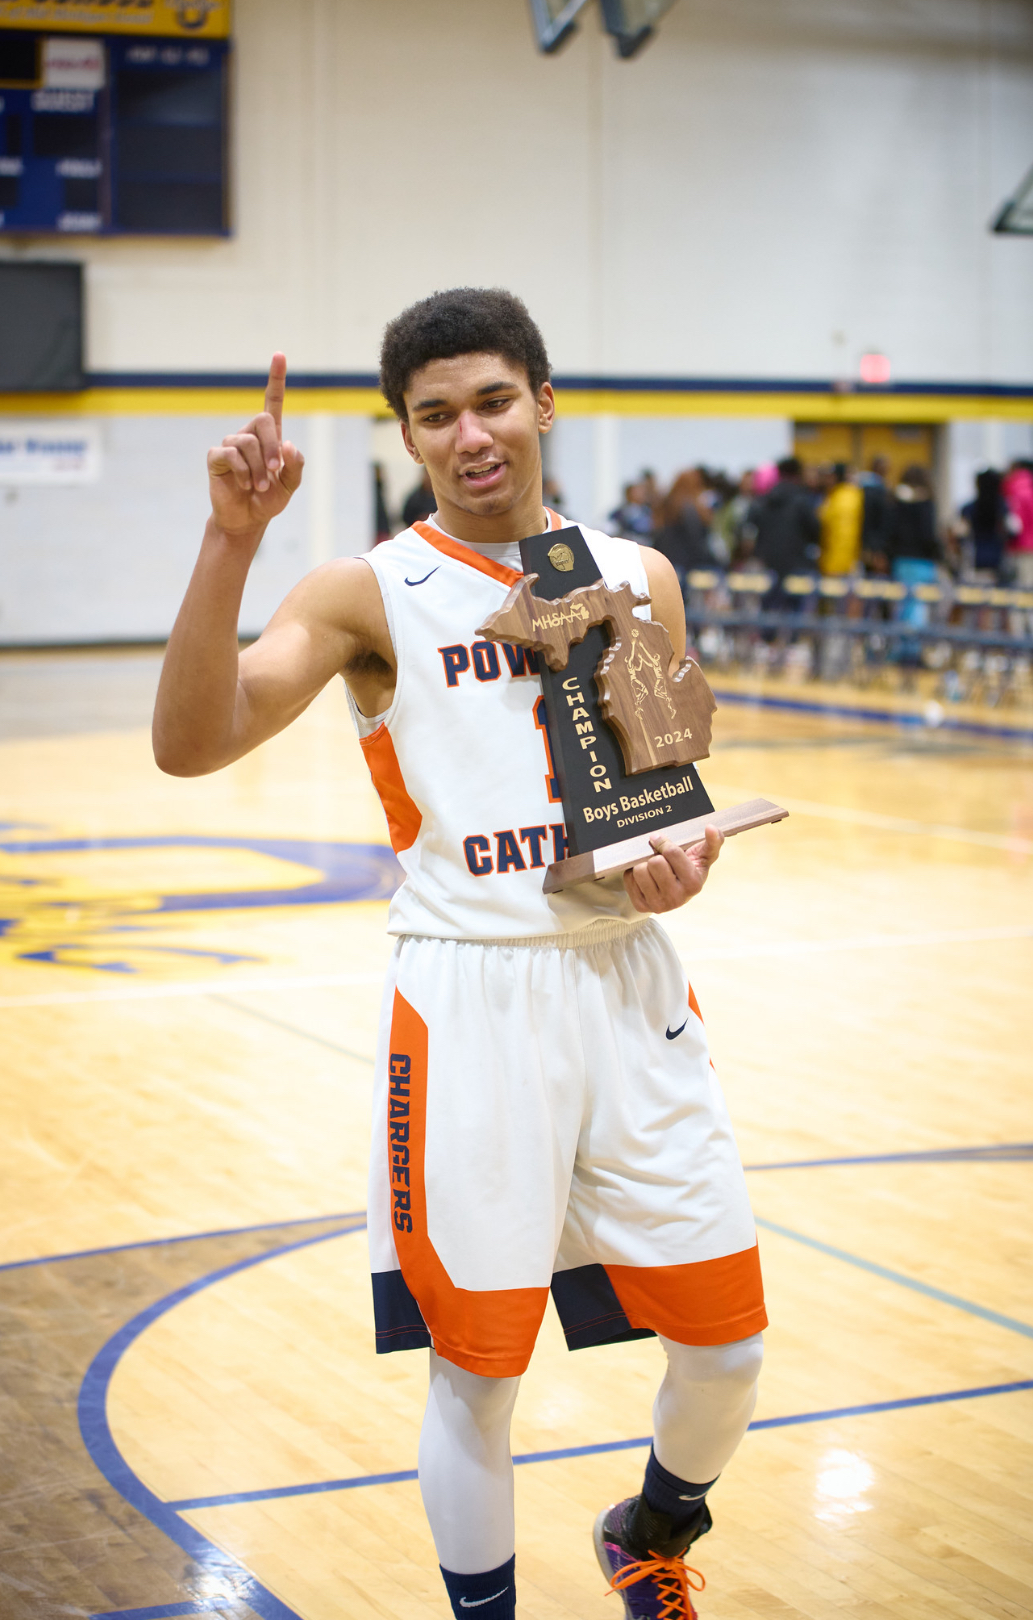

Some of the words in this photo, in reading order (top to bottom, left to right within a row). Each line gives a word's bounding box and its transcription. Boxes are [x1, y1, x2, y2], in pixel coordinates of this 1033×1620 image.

[532, 609, 583, 632] MHSAA
[562, 676, 612, 793] CHAMPION
[654, 728, 693, 748] 2024
[583, 802, 619, 823] Boys
[619, 775, 694, 812] Basketball
[616, 807, 665, 828] DIVISION
[665, 805, 673, 813] 2
[389, 1053, 413, 1234] CHARGERS
